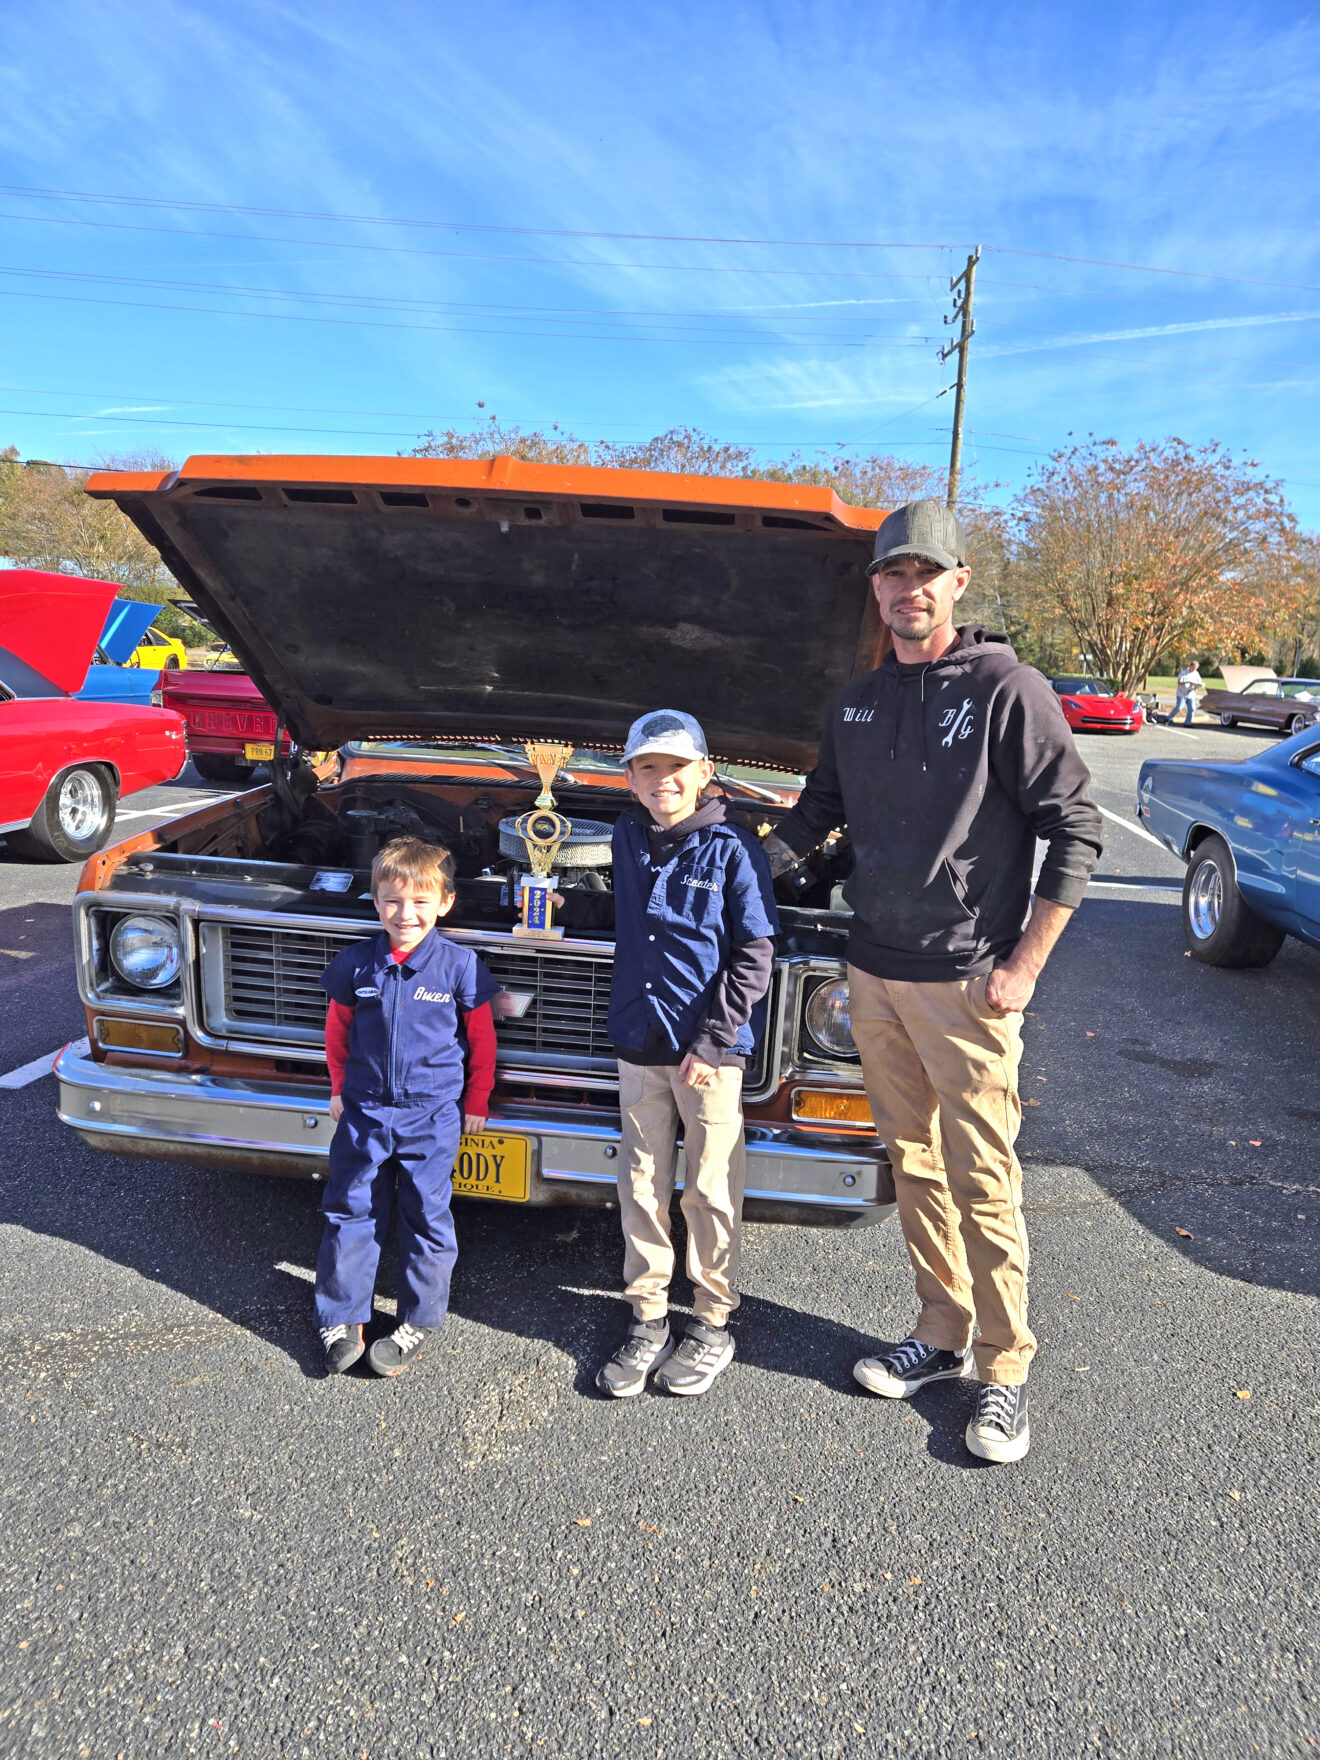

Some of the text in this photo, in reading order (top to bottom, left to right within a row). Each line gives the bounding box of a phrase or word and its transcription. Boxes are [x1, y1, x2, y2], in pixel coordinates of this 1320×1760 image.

[843, 707, 875, 722] Will
[680, 874, 719, 892] Scooter
[532, 890, 541, 924] 2024
[413, 986, 451, 1003] Owen
